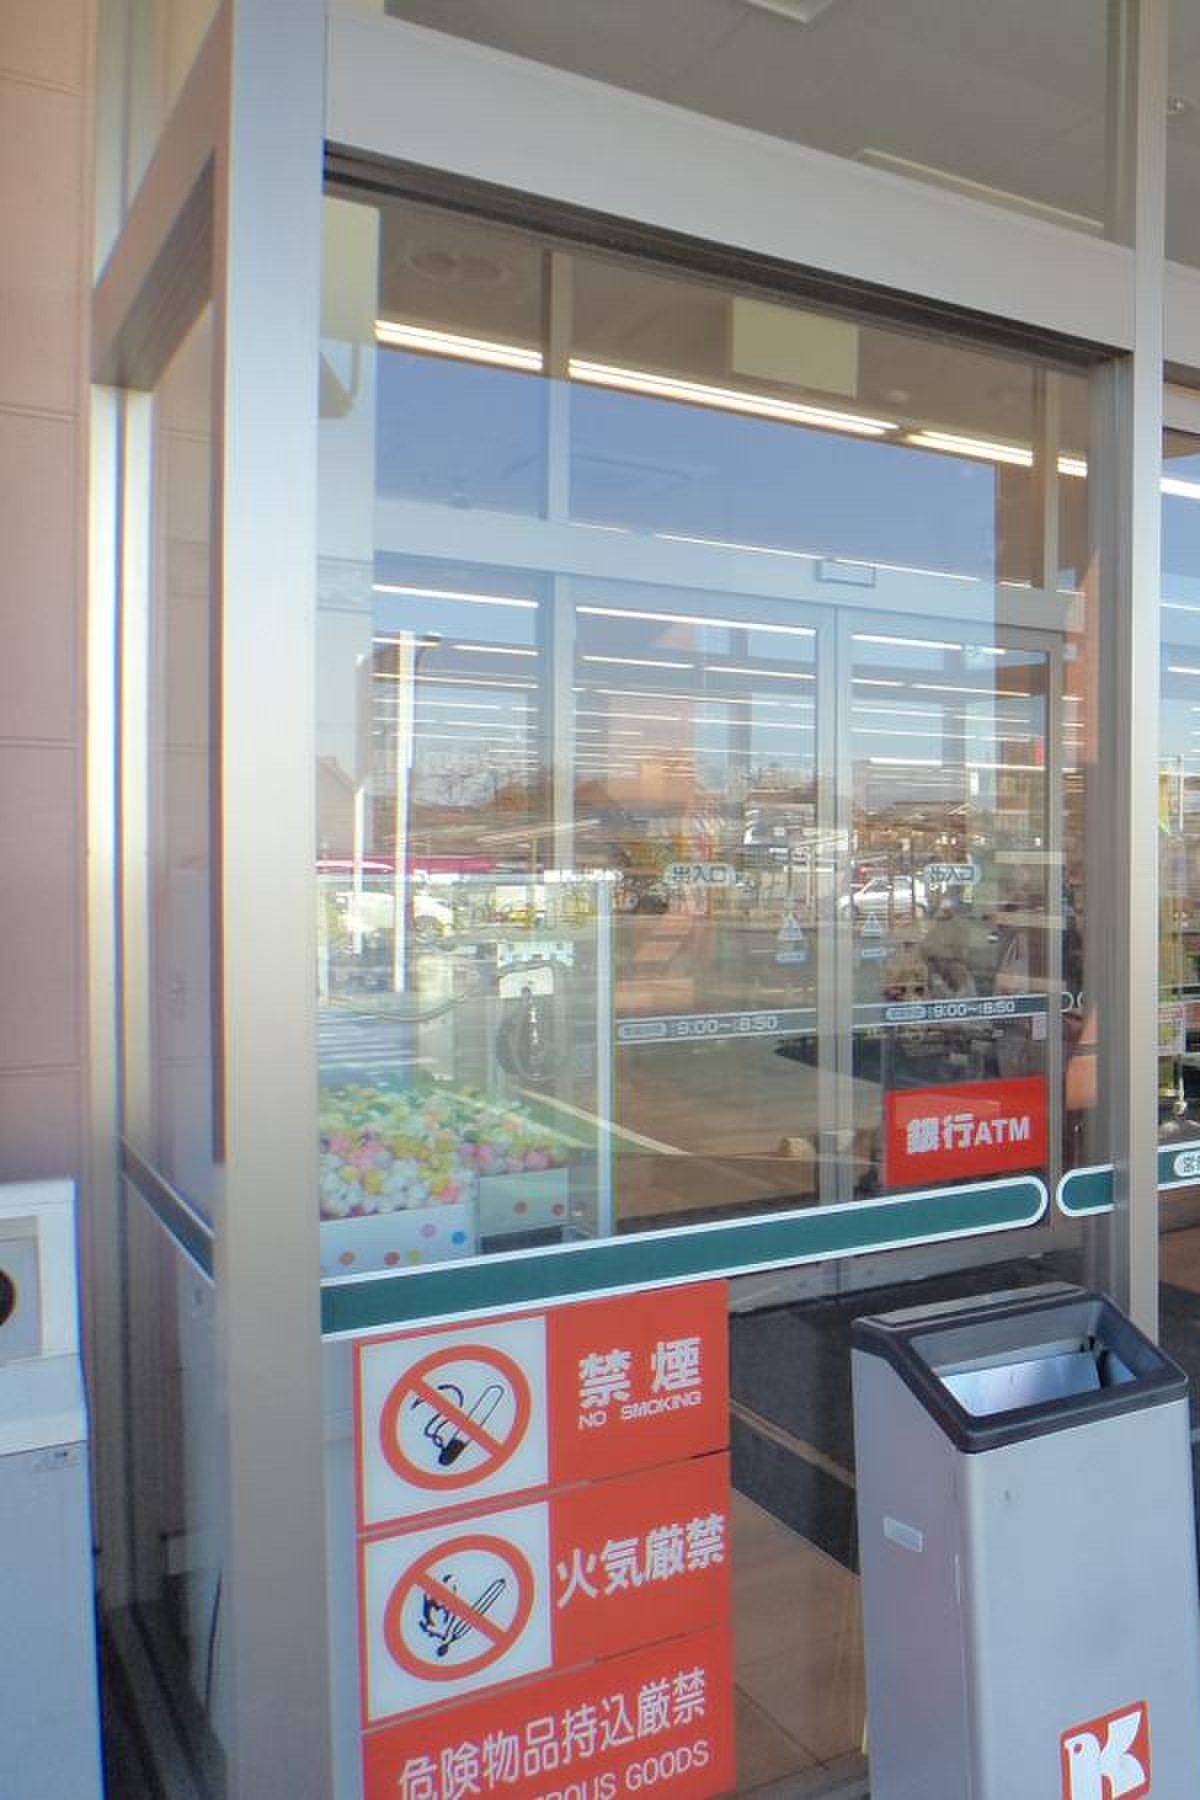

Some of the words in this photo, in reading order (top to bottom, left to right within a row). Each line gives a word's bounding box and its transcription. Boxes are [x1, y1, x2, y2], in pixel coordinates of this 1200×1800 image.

[670, 865, 728, 885] 出入口
[907, 1113, 1030, 1155] 銀行ATM
[578, 1337, 702, 1409] 禁煙
[578, 1410, 608, 1430] NO
[620, 1391, 703, 1420] SMOKING
[557, 1512, 726, 1609] 火気厳禁
[396, 1668, 706, 1800] 危険物品持込厳禁
[625, 1740, 710, 1791] GOODS
